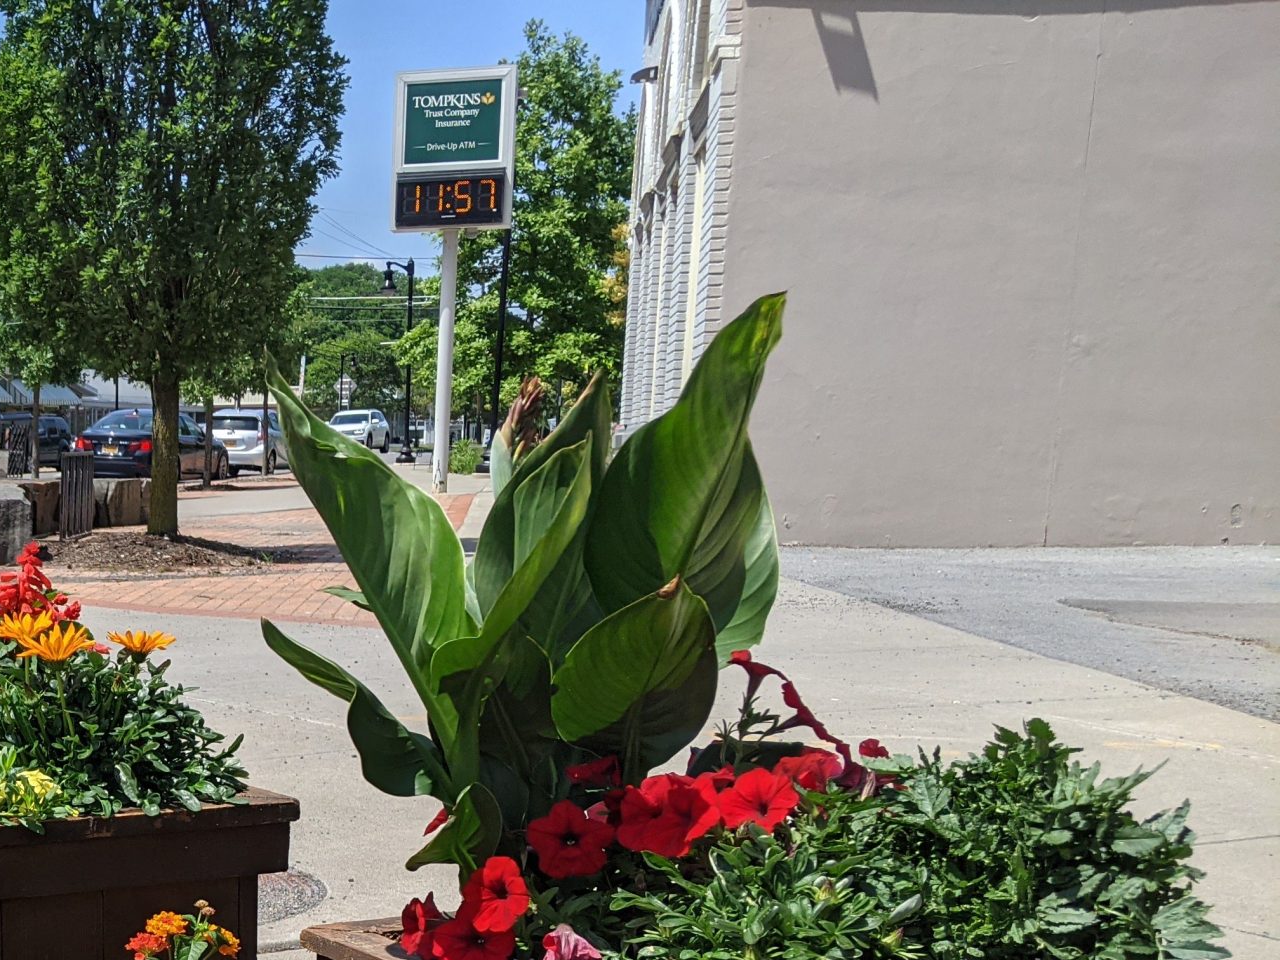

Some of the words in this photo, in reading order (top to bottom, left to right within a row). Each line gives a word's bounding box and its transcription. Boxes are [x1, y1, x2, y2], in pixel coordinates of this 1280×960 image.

[413, 93, 481, 109] TOMPKINS
[424, 110, 443, 118] Trust
[444, 108, 480, 119] Company
[435, 119, 471, 128] Insurance
[427, 141, 458, 151] Drive-Up
[459, 141, 476, 149] ATM
[414, 179, 496, 213] 11:57
